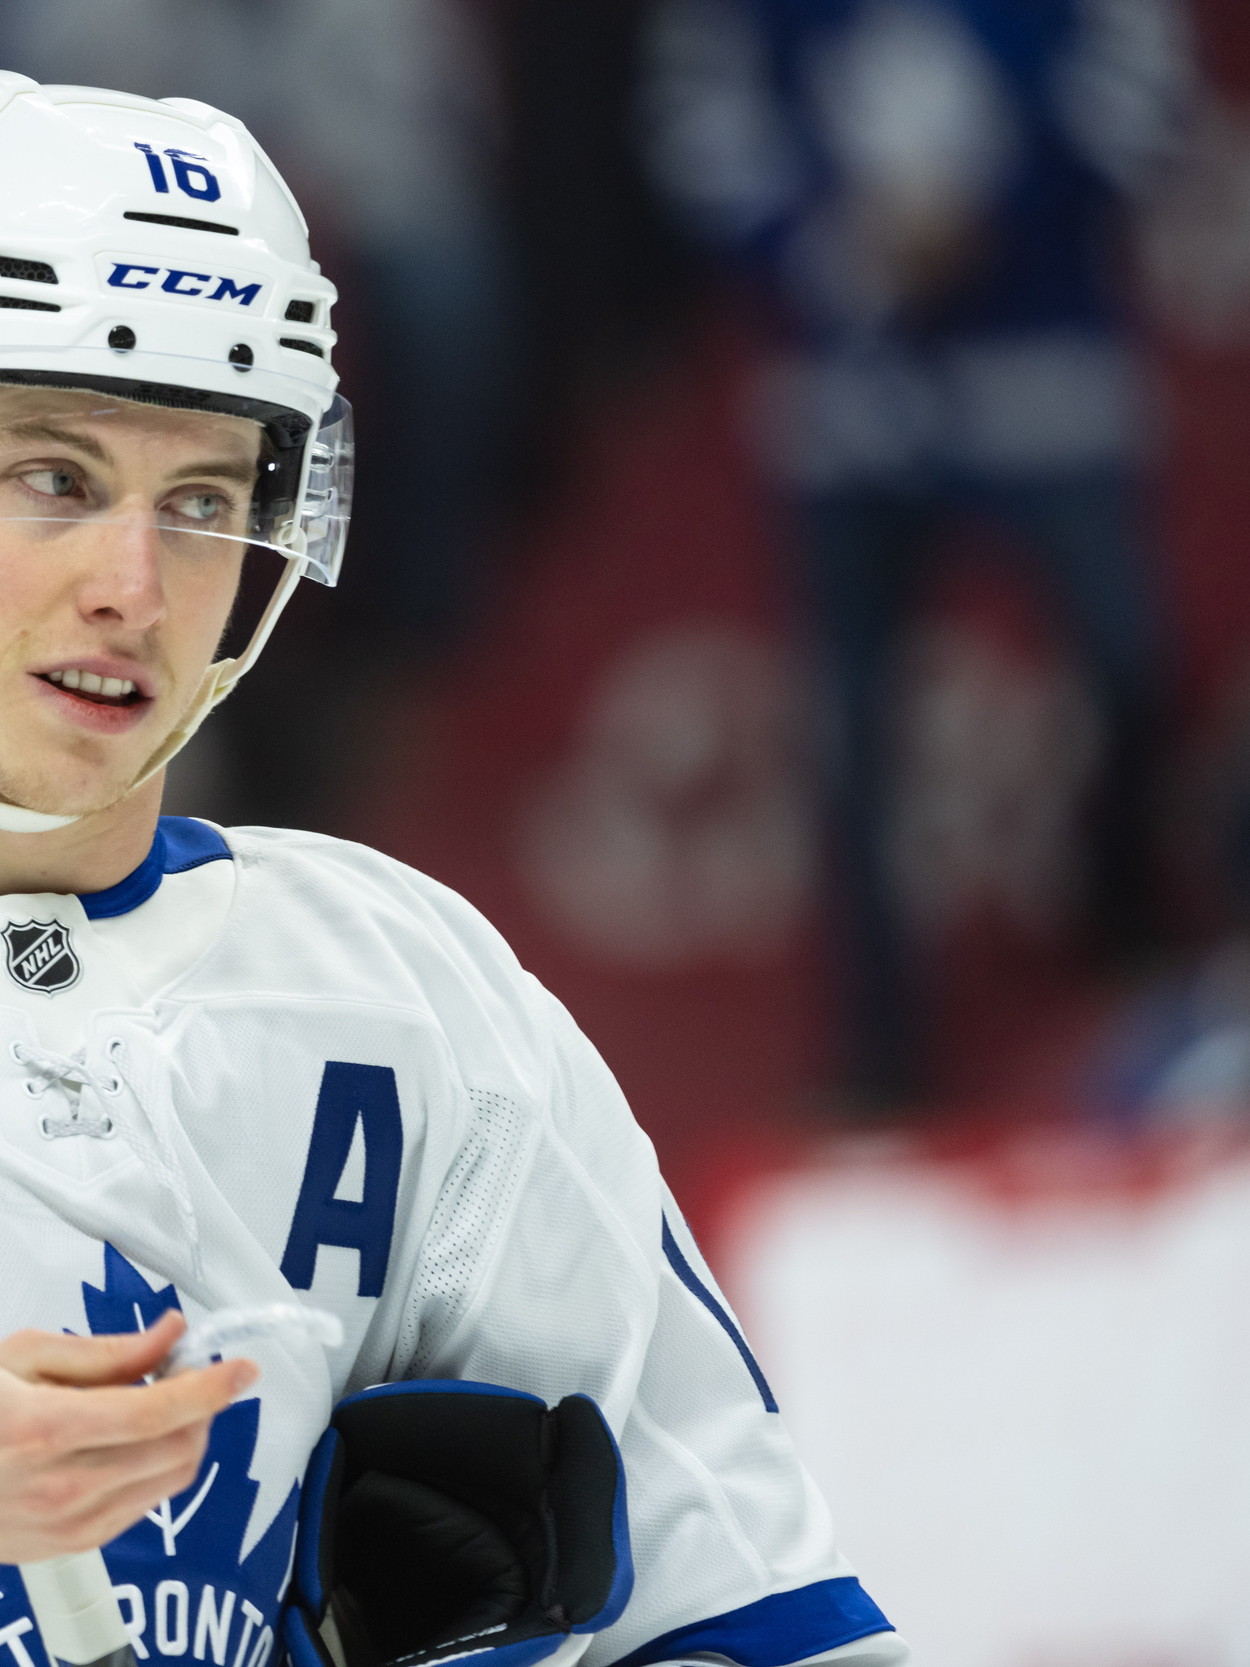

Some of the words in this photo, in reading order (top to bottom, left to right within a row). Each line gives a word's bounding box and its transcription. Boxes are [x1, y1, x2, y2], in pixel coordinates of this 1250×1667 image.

[134, 142, 221, 203] 16
[107, 262, 264, 307] CCM
[21, 936, 63, 980] NHL
[279, 1060, 404, 1298] A
